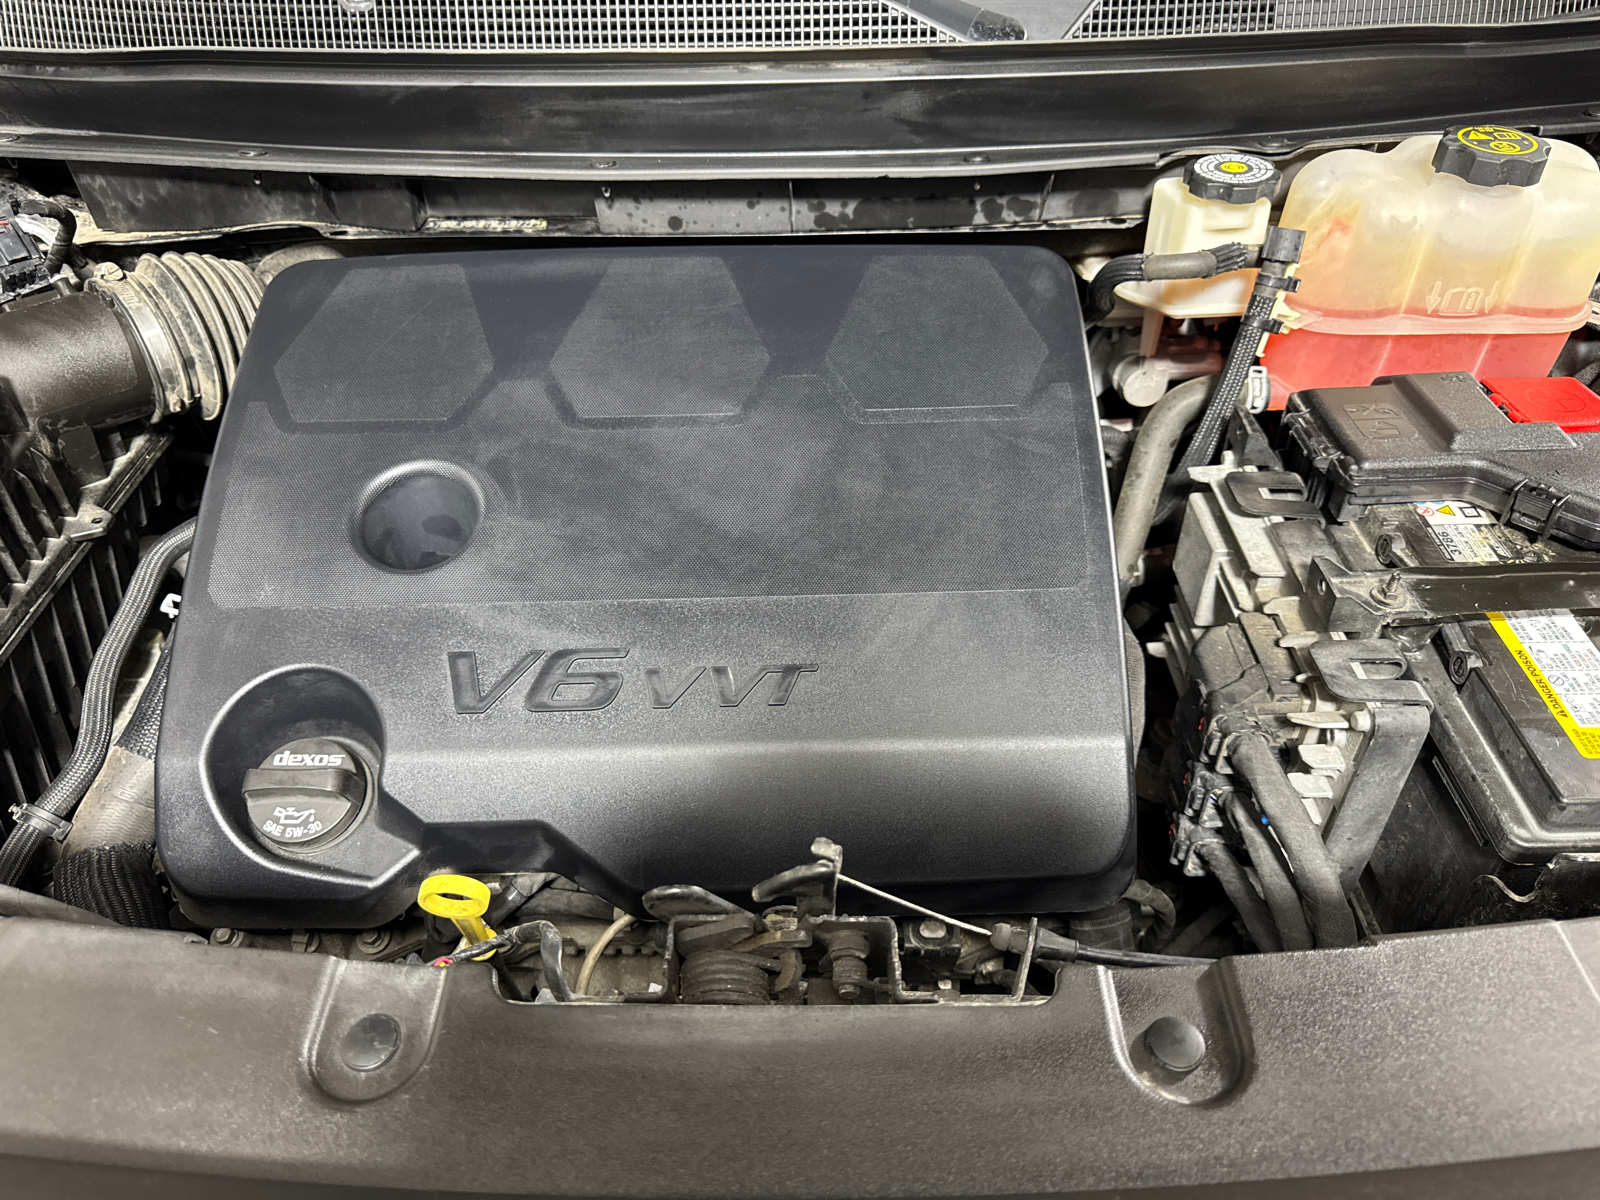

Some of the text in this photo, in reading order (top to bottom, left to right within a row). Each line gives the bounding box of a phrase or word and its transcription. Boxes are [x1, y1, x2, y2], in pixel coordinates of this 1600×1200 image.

[1437, 530, 1462, 556] 3786
[447, 647, 819, 714] V6 VVT
[273, 750, 346, 766] dexos
[262, 820, 323, 838] SAE 5W-30
